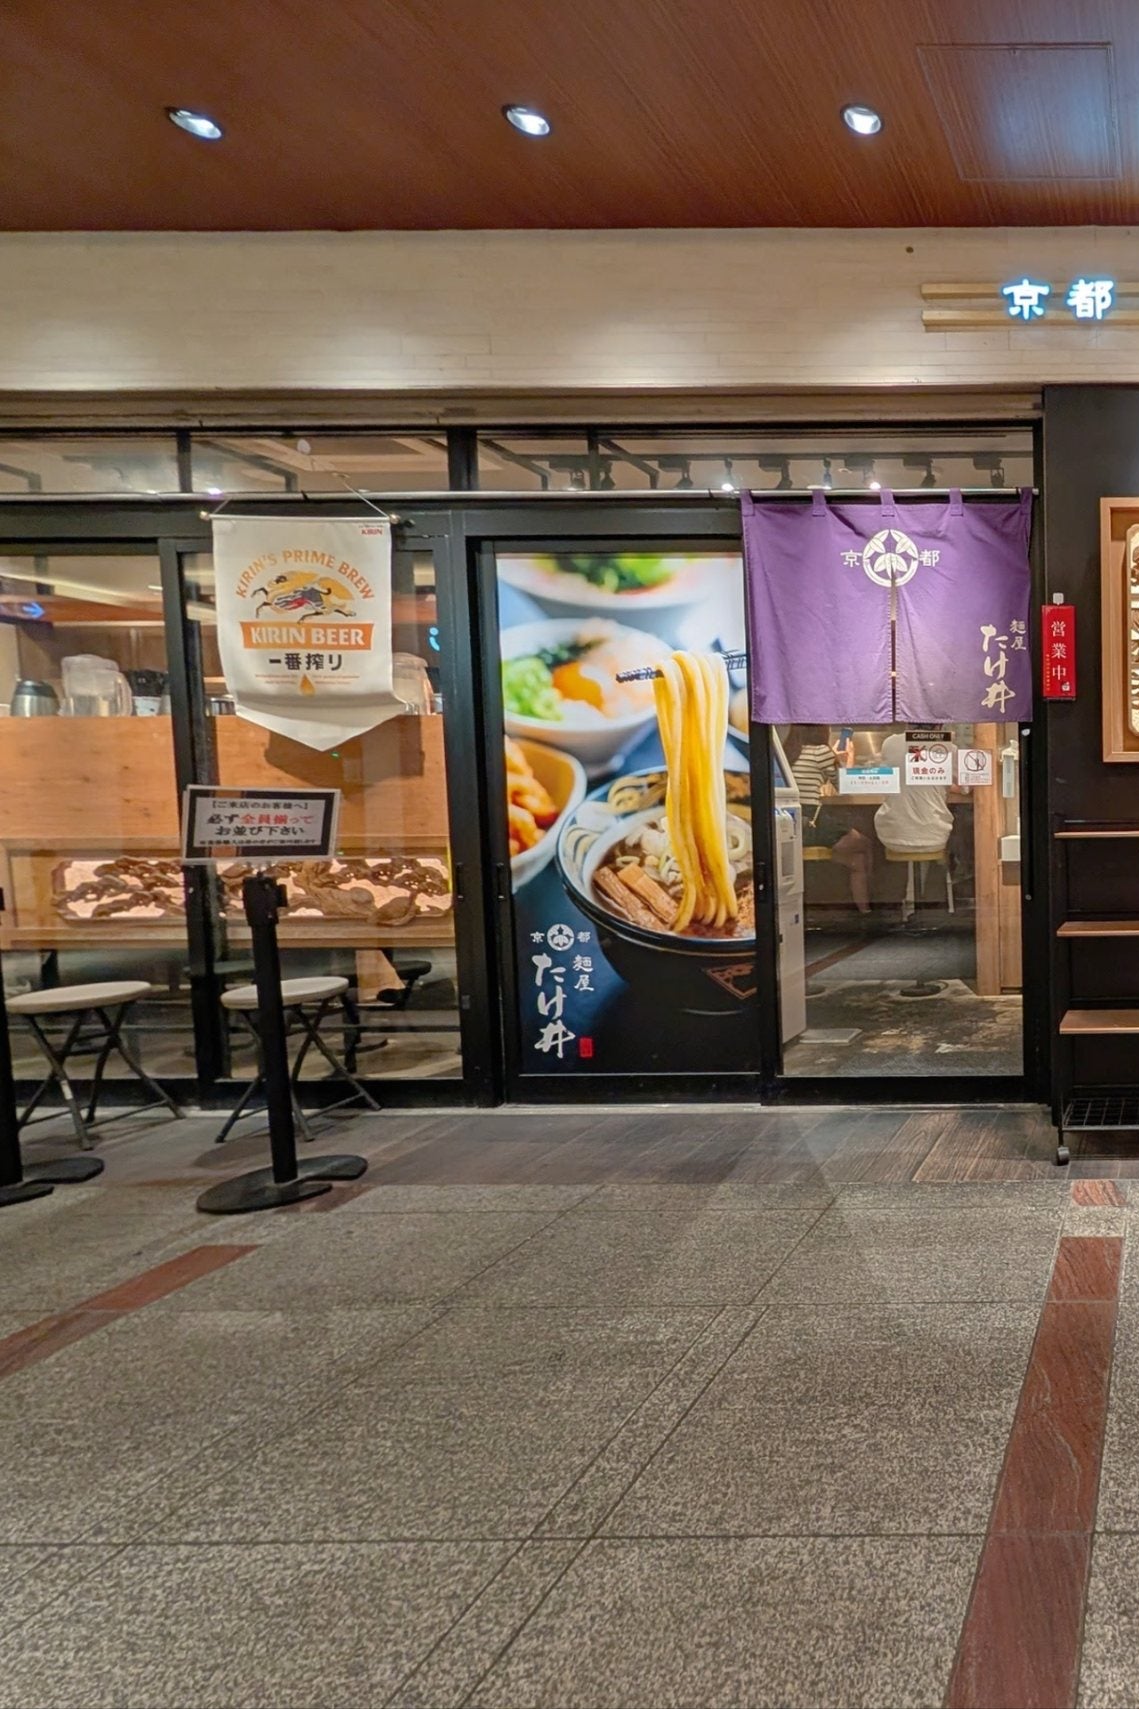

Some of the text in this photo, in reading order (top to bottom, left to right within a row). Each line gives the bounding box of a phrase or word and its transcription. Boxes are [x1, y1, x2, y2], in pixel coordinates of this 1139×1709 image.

[1002, 278, 1114, 321] 京都
[235, 550, 375, 601] KIRIN'S PRIME BREW
[250, 626, 366, 646] KIRIN BEER
[268, 652, 343, 672] 一番搾り
[1050, 620, 1067, 681] 営業中
[980, 624, 1016, 714] たけ井
[912, 732, 945, 740] CASH ONLY
[912, 767, 945, 775] 現金のみ
[207, 814, 314, 825] 必ず全員揃って
[215, 825, 305, 836] お並び下さい
[572, 954, 594, 991] 麺屋
[531, 952, 576, 1059] たけ井
